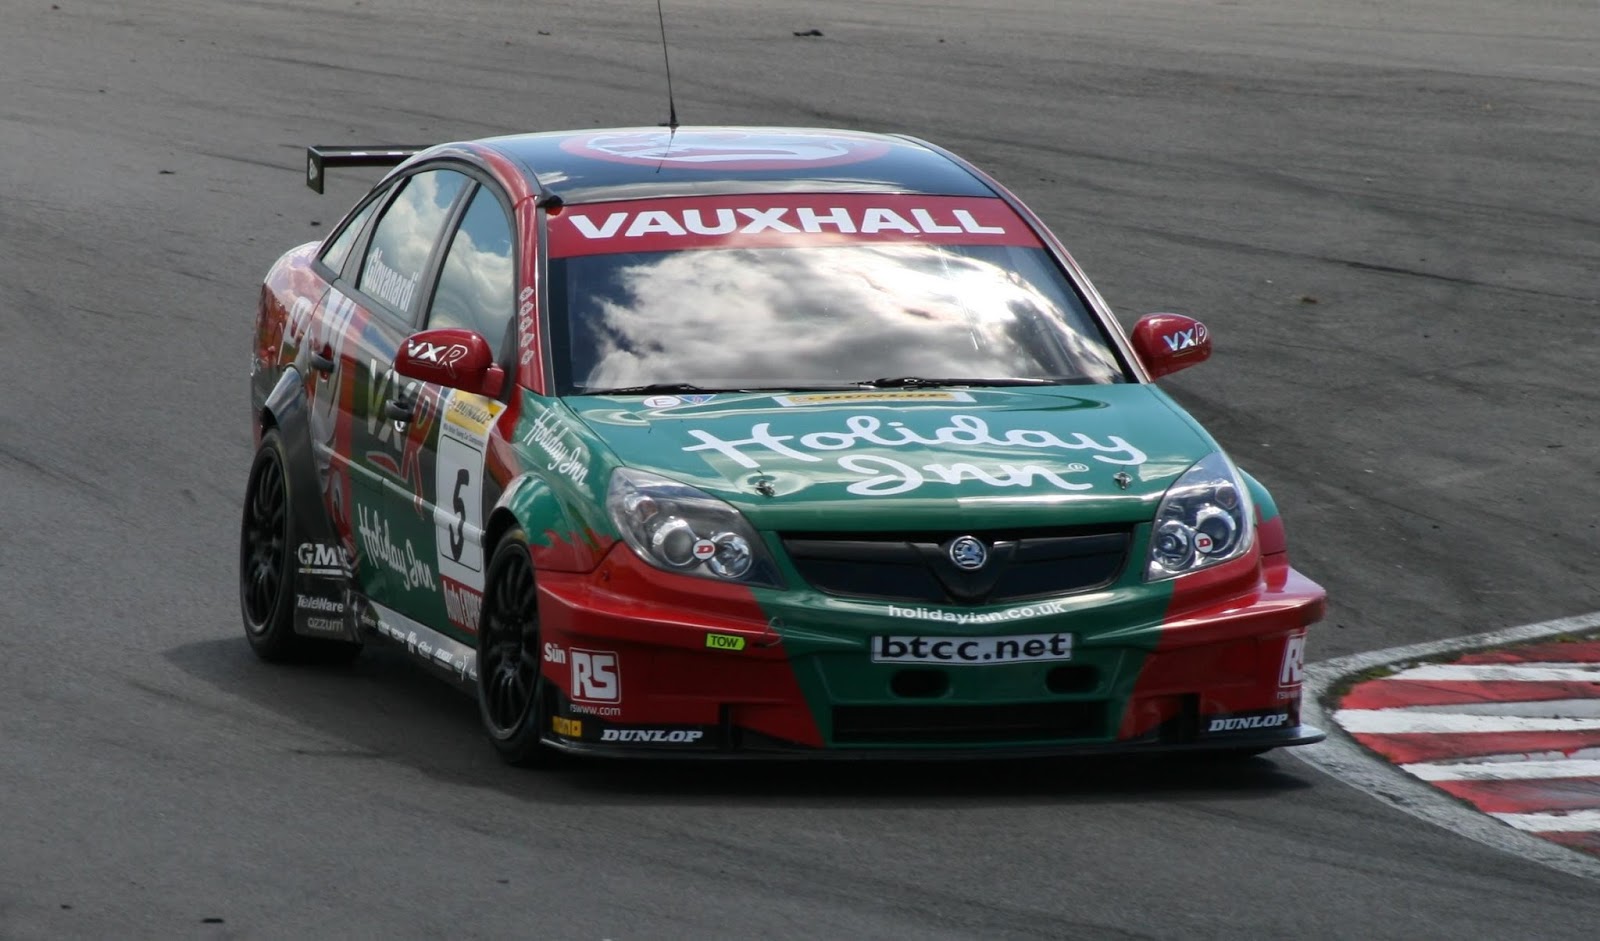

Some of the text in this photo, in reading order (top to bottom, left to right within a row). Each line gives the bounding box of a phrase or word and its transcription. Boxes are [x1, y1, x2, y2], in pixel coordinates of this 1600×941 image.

[568, 207, 1006, 239] VAUXHALL
[681, 415, 1148, 465] Holiday
[449, 469, 470, 562] 5
[888, 603, 1067, 625] holidayinn.co.uk
[710, 635, 739, 648] TOW
[881, 634, 1067, 661] btcc.net
[571, 651, 617, 699] RS
[600, 729, 703, 743] DUNLOP
[1208, 713, 1289, 732] DUNLOP
